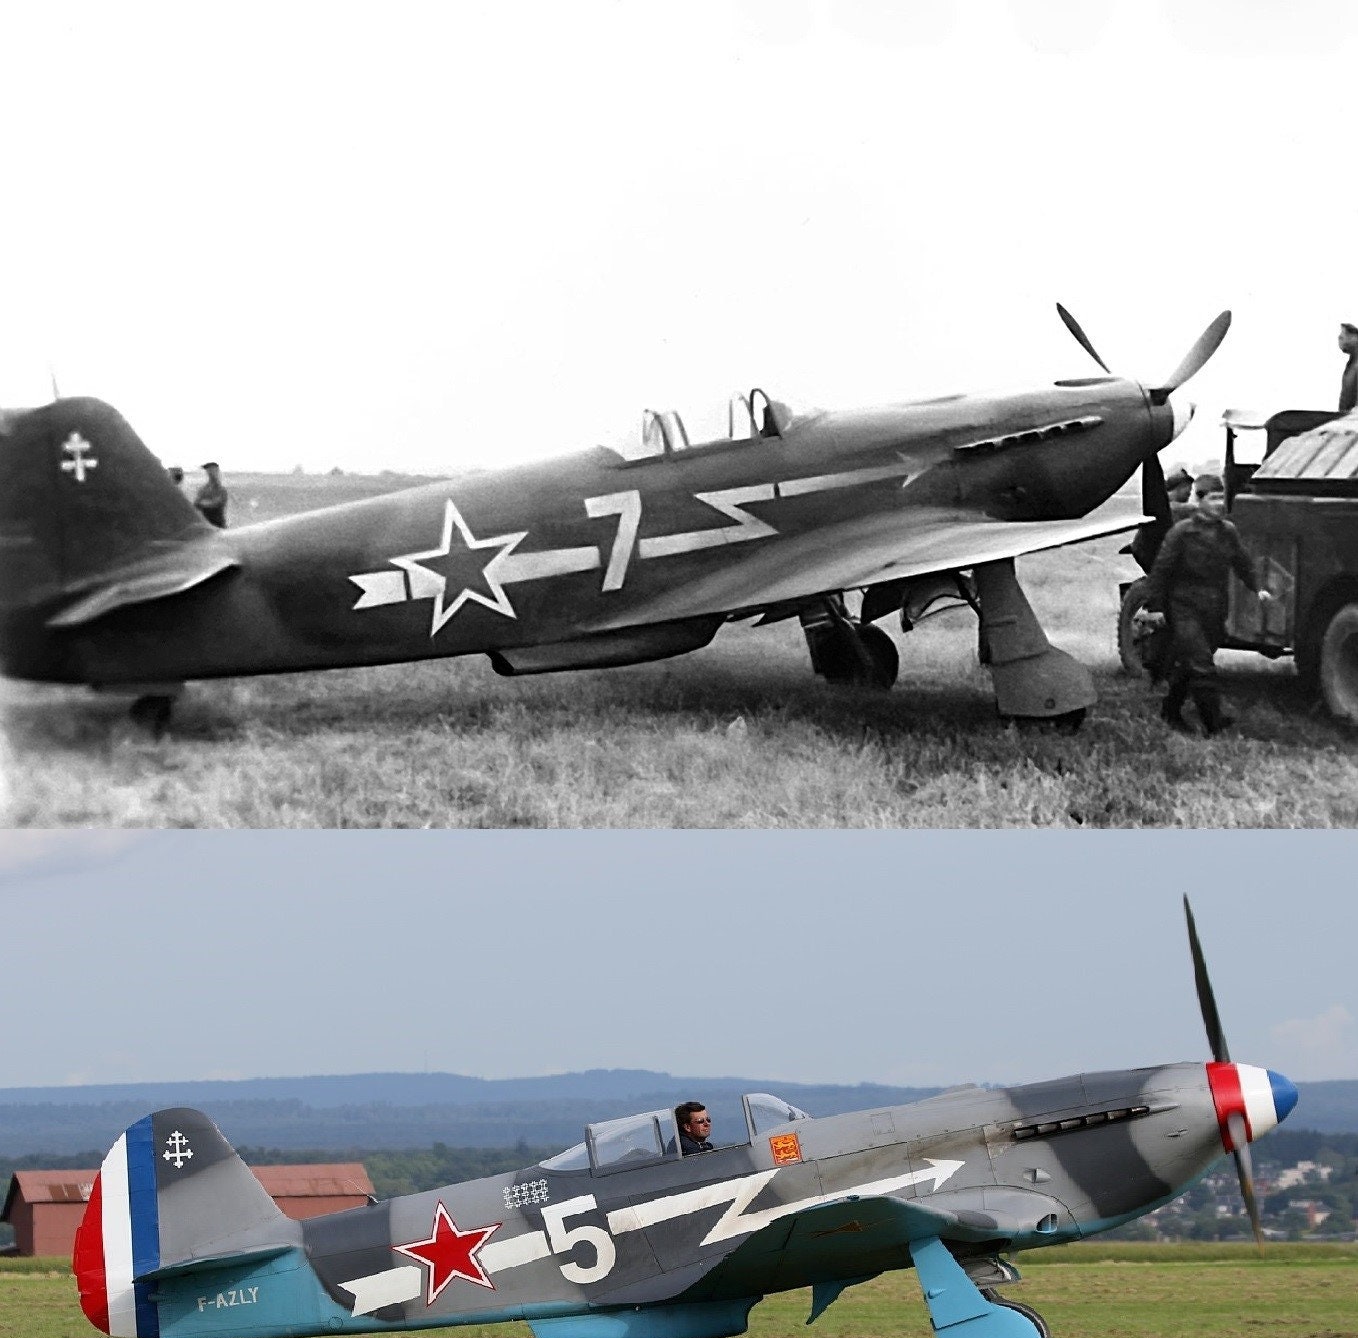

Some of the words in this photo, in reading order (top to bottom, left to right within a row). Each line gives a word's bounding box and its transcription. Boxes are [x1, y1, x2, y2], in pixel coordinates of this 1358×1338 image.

[584, 489, 641, 592] 7
[540, 1194, 616, 1284] 5
[197, 1286, 259, 1312] F-AZLY
